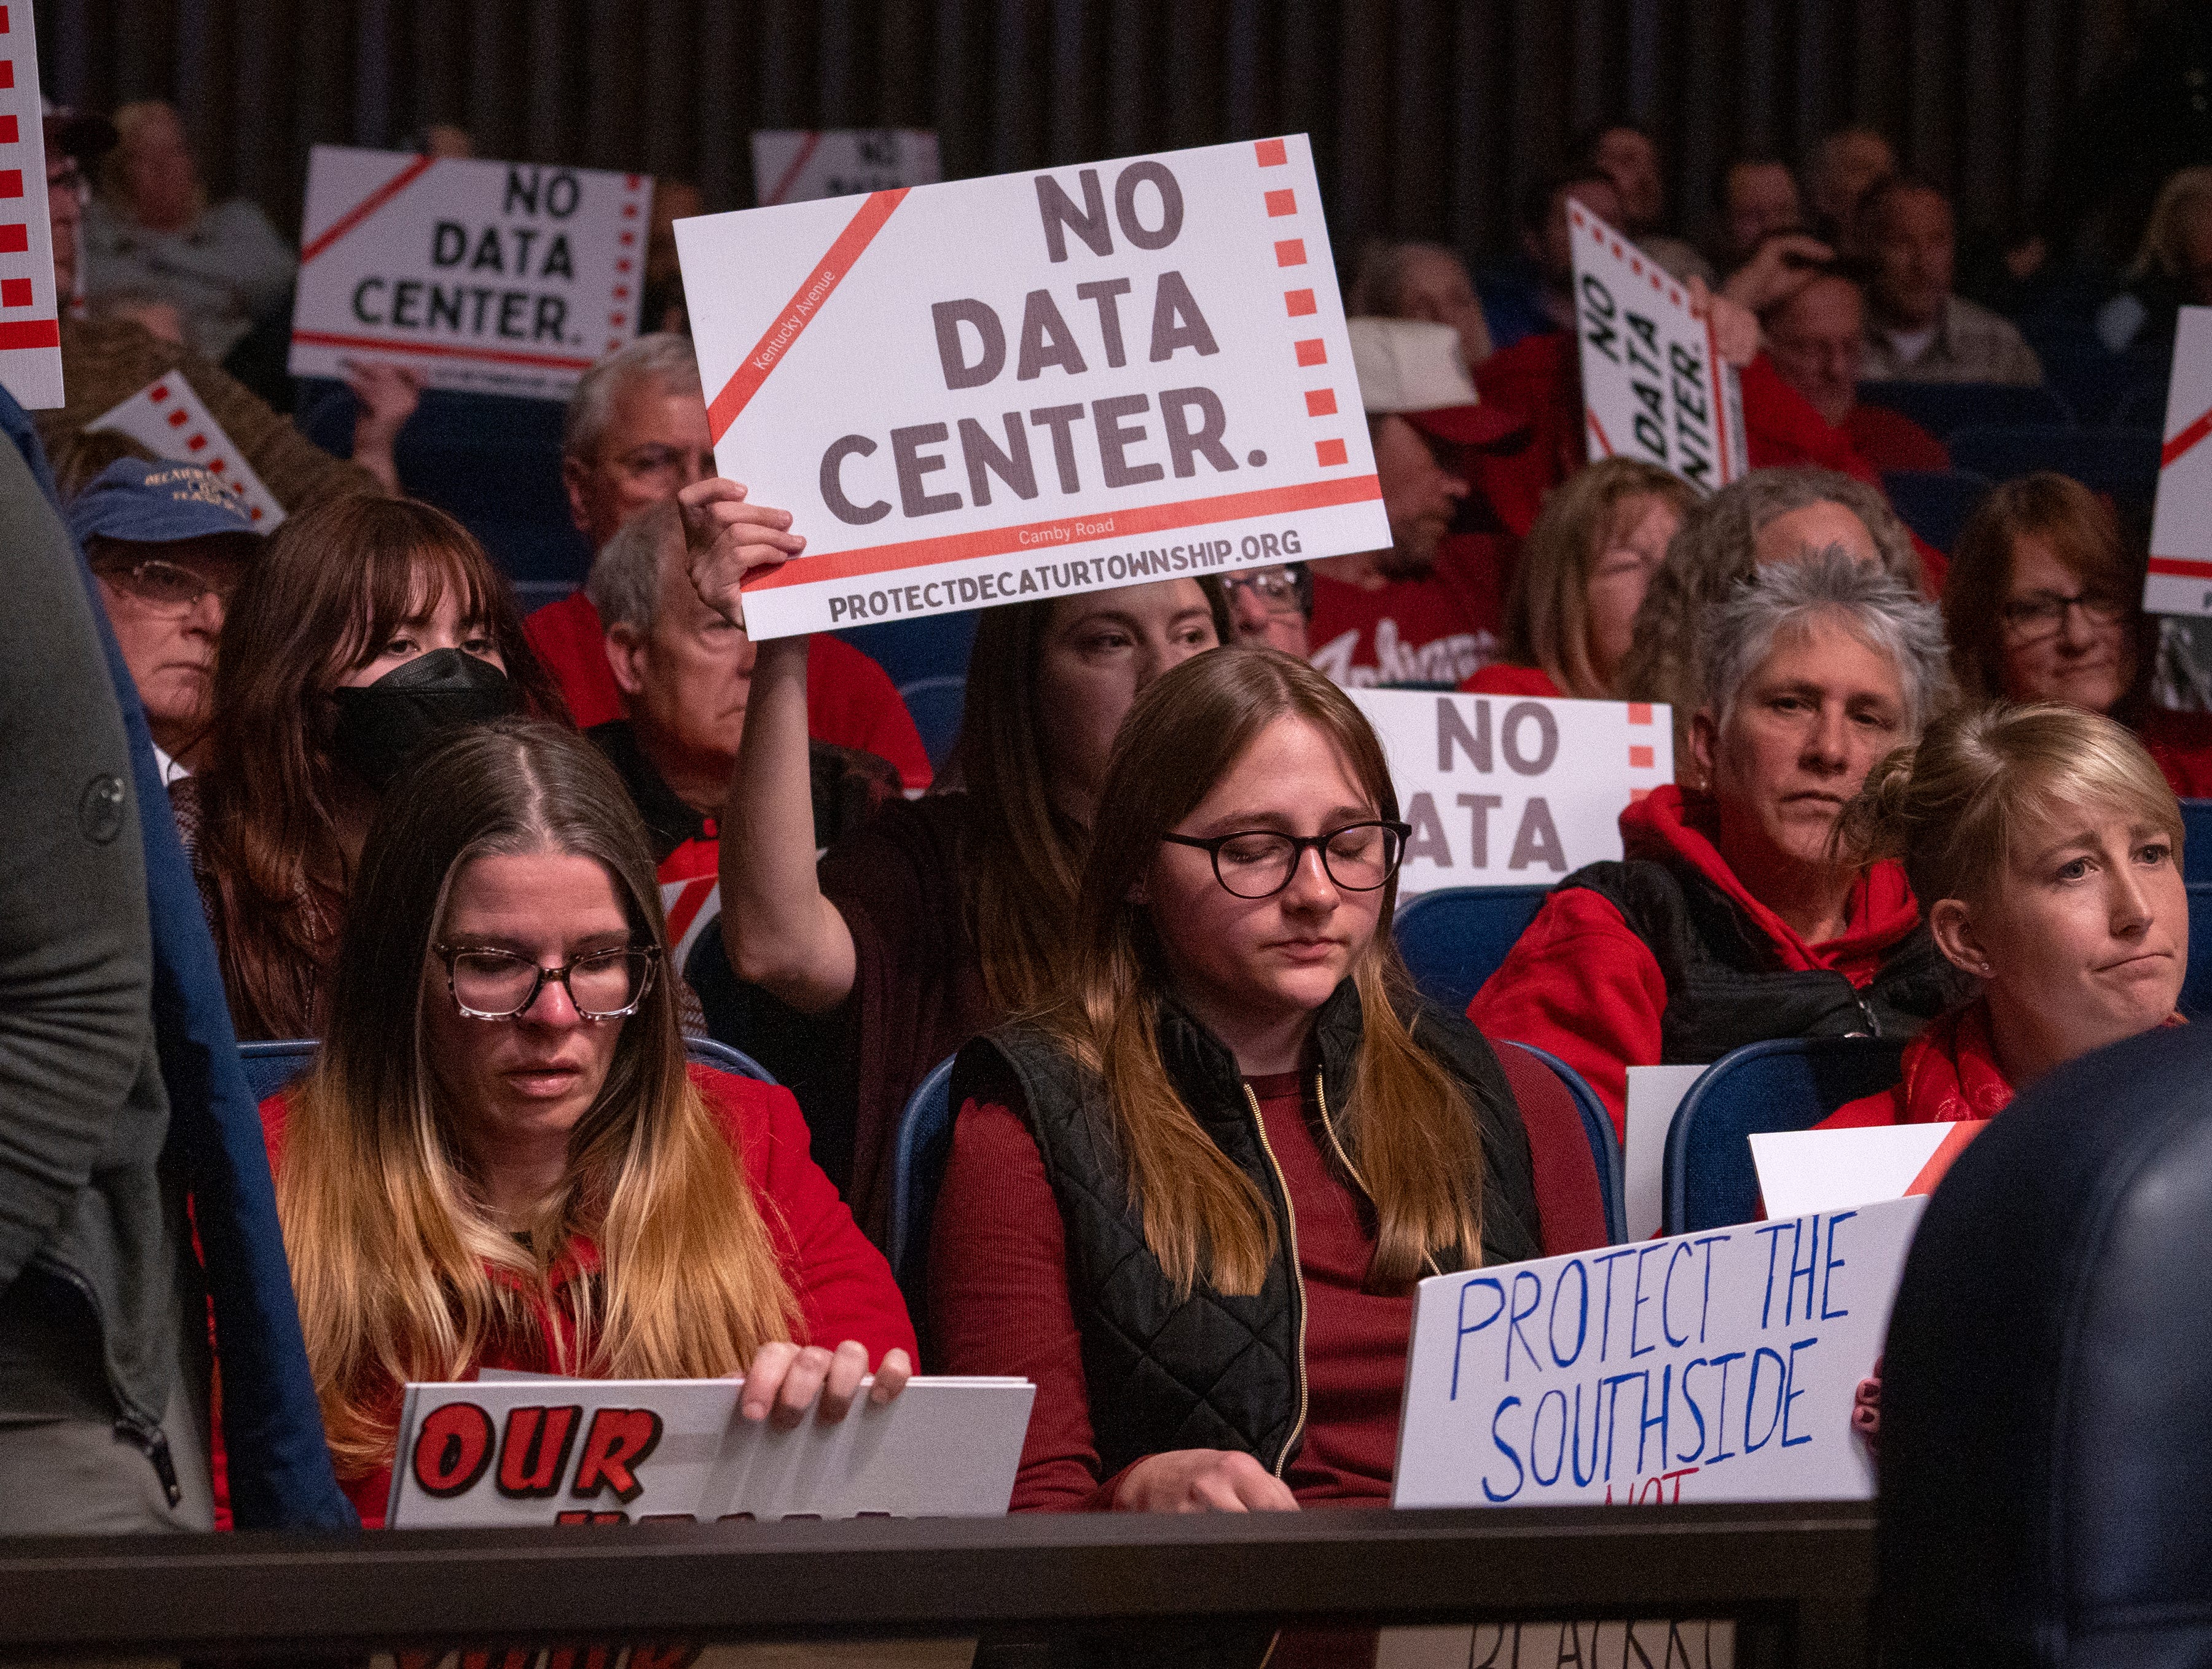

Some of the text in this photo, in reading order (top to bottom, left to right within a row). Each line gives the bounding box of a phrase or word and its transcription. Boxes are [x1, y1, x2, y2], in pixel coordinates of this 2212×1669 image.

[503, 165, 581, 219] NO
[1034, 161, 1184, 263] NO
[432, 220, 575, 281] DATA
[351, 276, 583, 345] CENTER.
[753, 270, 836, 370] Kentucky Avenue
[931, 271, 1220, 389] DATA
[1582, 273, 1621, 364] NO
[1625, 310, 1669, 462] DATA
[1669, 340, 1716, 493] NTER.
[820, 387, 1268, 525] CENTER.
[829, 530, 1302, 622] PROTECTDECATURTOWNSHIP.ORG
[1018, 518, 1115, 545] Camby Road
[1436, 697, 1559, 776] NO
[1402, 791, 1569, 873] ATA
[1449, 1210, 1858, 1401] PROTECT THE
[413, 1401, 664, 1504] OUR
[1482, 1337, 1819, 1503] SOUTHSIDE
